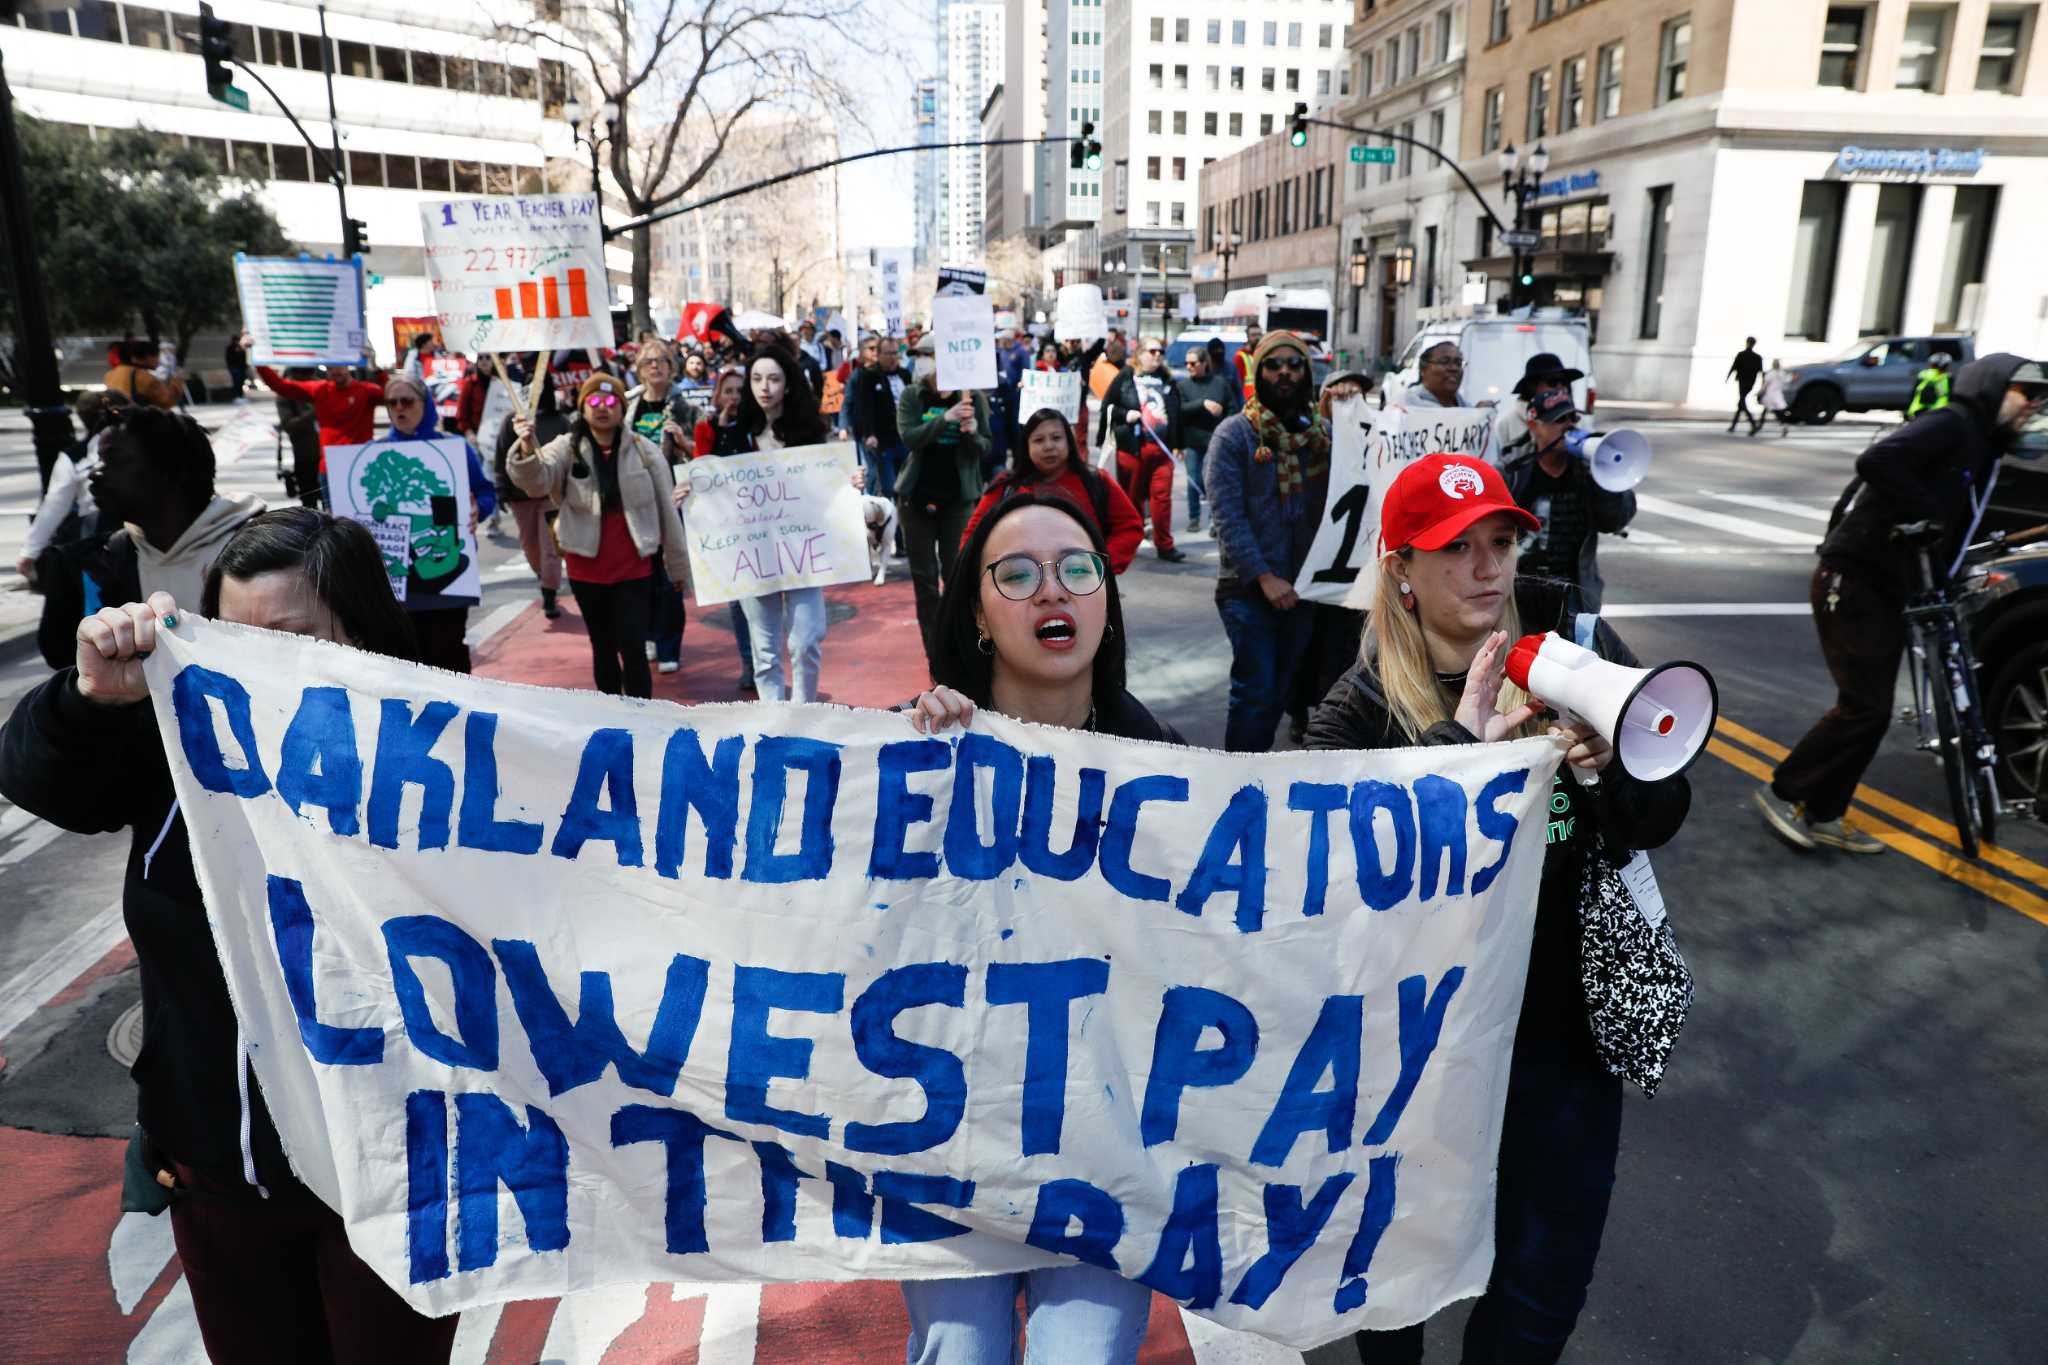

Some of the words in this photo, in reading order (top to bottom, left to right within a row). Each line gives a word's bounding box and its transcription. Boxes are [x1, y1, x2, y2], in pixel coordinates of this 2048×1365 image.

[472, 202, 511, 221] YEAR
[517, 200, 566, 219] TEACHER
[571, 199, 595, 216] PAY
[948, 338, 983, 353] NEED
[689, 465, 776, 493] SCHOOLS
[737, 480, 801, 510] SOUL
[700, 533, 743, 553] KEEP
[733, 533, 833, 583] ALIVE
[173, 663, 844, 884] OAKLAND
[867, 733, 1530, 933] EDUCATORS
[267, 874, 1111, 1157] LOWEST
[1140, 965, 1467, 1168] PAY
[404, 1088, 571, 1286] IN
[611, 1103, 977, 1254] THE
[1025, 1152, 1402, 1315] BAY!
